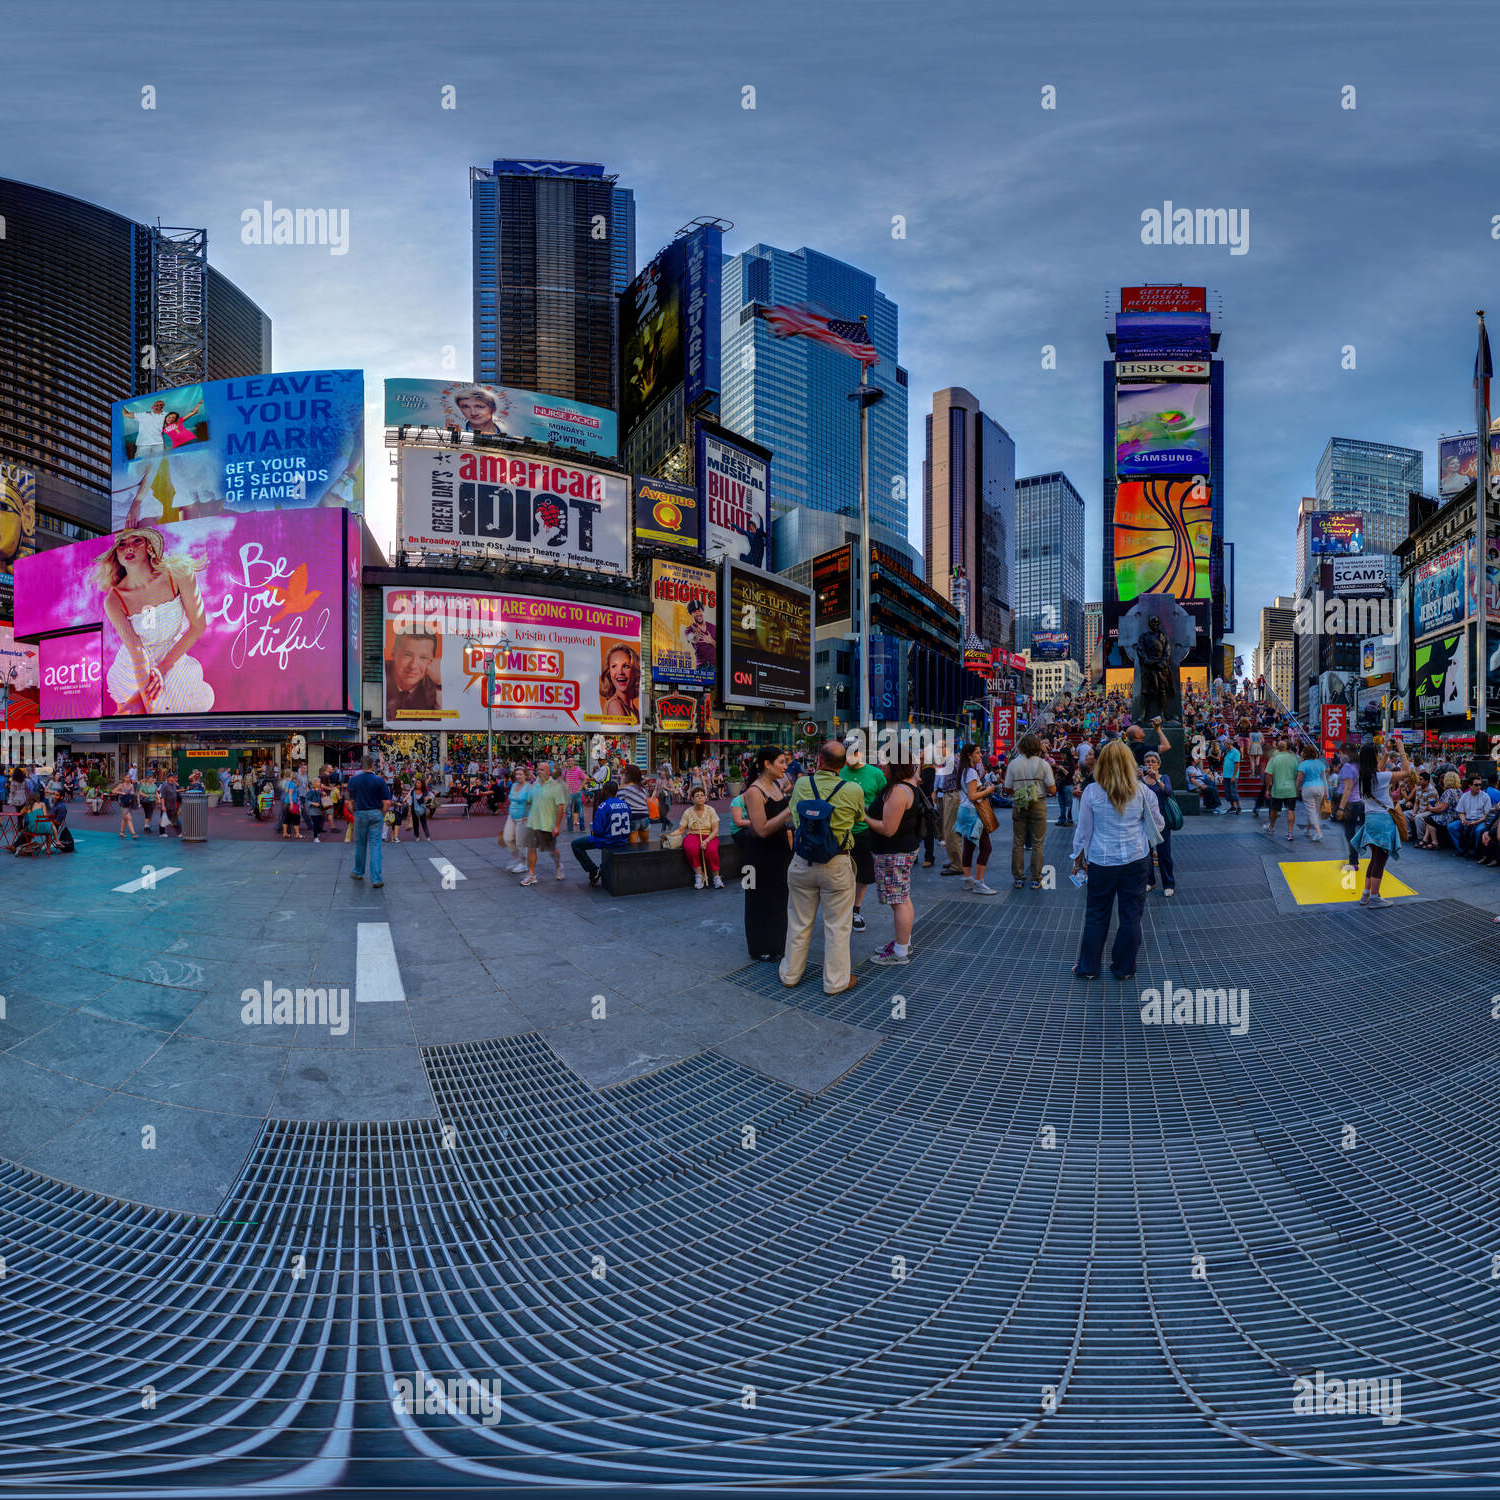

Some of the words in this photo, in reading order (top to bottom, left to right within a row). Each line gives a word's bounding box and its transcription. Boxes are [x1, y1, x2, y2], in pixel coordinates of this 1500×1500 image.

[158, 253, 178, 283] EAGLE
[182, 264, 202, 325] OUTFITTERS
[158, 283, 178, 342] AMERICAN
[1121, 363, 1175, 374] HSBC
[227, 374, 333, 401] LEAVE
[237, 399, 333, 426] YOUR
[534, 407, 567, 420] NURSE
[568, 414, 599, 427] JACKIE
[227, 427, 333, 456] MARK
[548, 423, 584, 436] MONDAYS
[225, 461, 255, 476] GET
[263, 457, 307, 471] YOUR
[721, 453, 753, 475] BEST
[1134, 454, 1193, 463] SAMSUNG
[226, 475, 245, 488] 15
[250, 469, 329, 485] SECONDS
[458, 453, 602, 502] american
[707, 456, 765, 492] MUSICAL
[226, 489, 248, 503] OF
[639, 486, 697, 509] Avenue
[708, 470, 747, 508] BILLY
[432, 493, 453, 533] GREEN
[458, 481, 602, 553] IDIOT
[653, 501, 683, 532] Q
[708, 495, 753, 536] ELLIOT
[408, 535, 419, 544] On
[420, 536, 460, 547] Broadway
[471, 540, 485, 548] the
[495, 542, 506, 550] St.
[506, 544, 531, 554] James
[532, 547, 560, 558] Theatre
[567, 553, 620, 568] Telecharge.com
[1433, 545, 1464, 568] CROWD
[672, 577, 689, 586] THE
[1334, 569, 1384, 582] SCAM?
[655, 579, 717, 608] HEIGHTS
[742, 586, 766, 604] KING
[767, 595, 786, 609] TUT
[411, 594, 471, 611] PROMISE
[473, 597, 498, 613] YOU
[501, 600, 526, 617] ARE
[529, 602, 566, 620] GOING
[568, 606, 584, 621] TO
[586, 609, 613, 626] LOVE
[1419, 599, 1443, 622] JERSEY
[515, 628, 546, 643] Kristin
[548, 632, 596, 648] Chenoweth
[0, 648, 23, 657] America
[44, 657, 101, 687] aerie
[733, 671, 753, 686] CNN
[1418, 694, 1441, 710] WICKED
[998, 708, 1012, 737] tkts
[1327, 707, 1344, 738] tkts
[610, 812, 631, 836] 23
